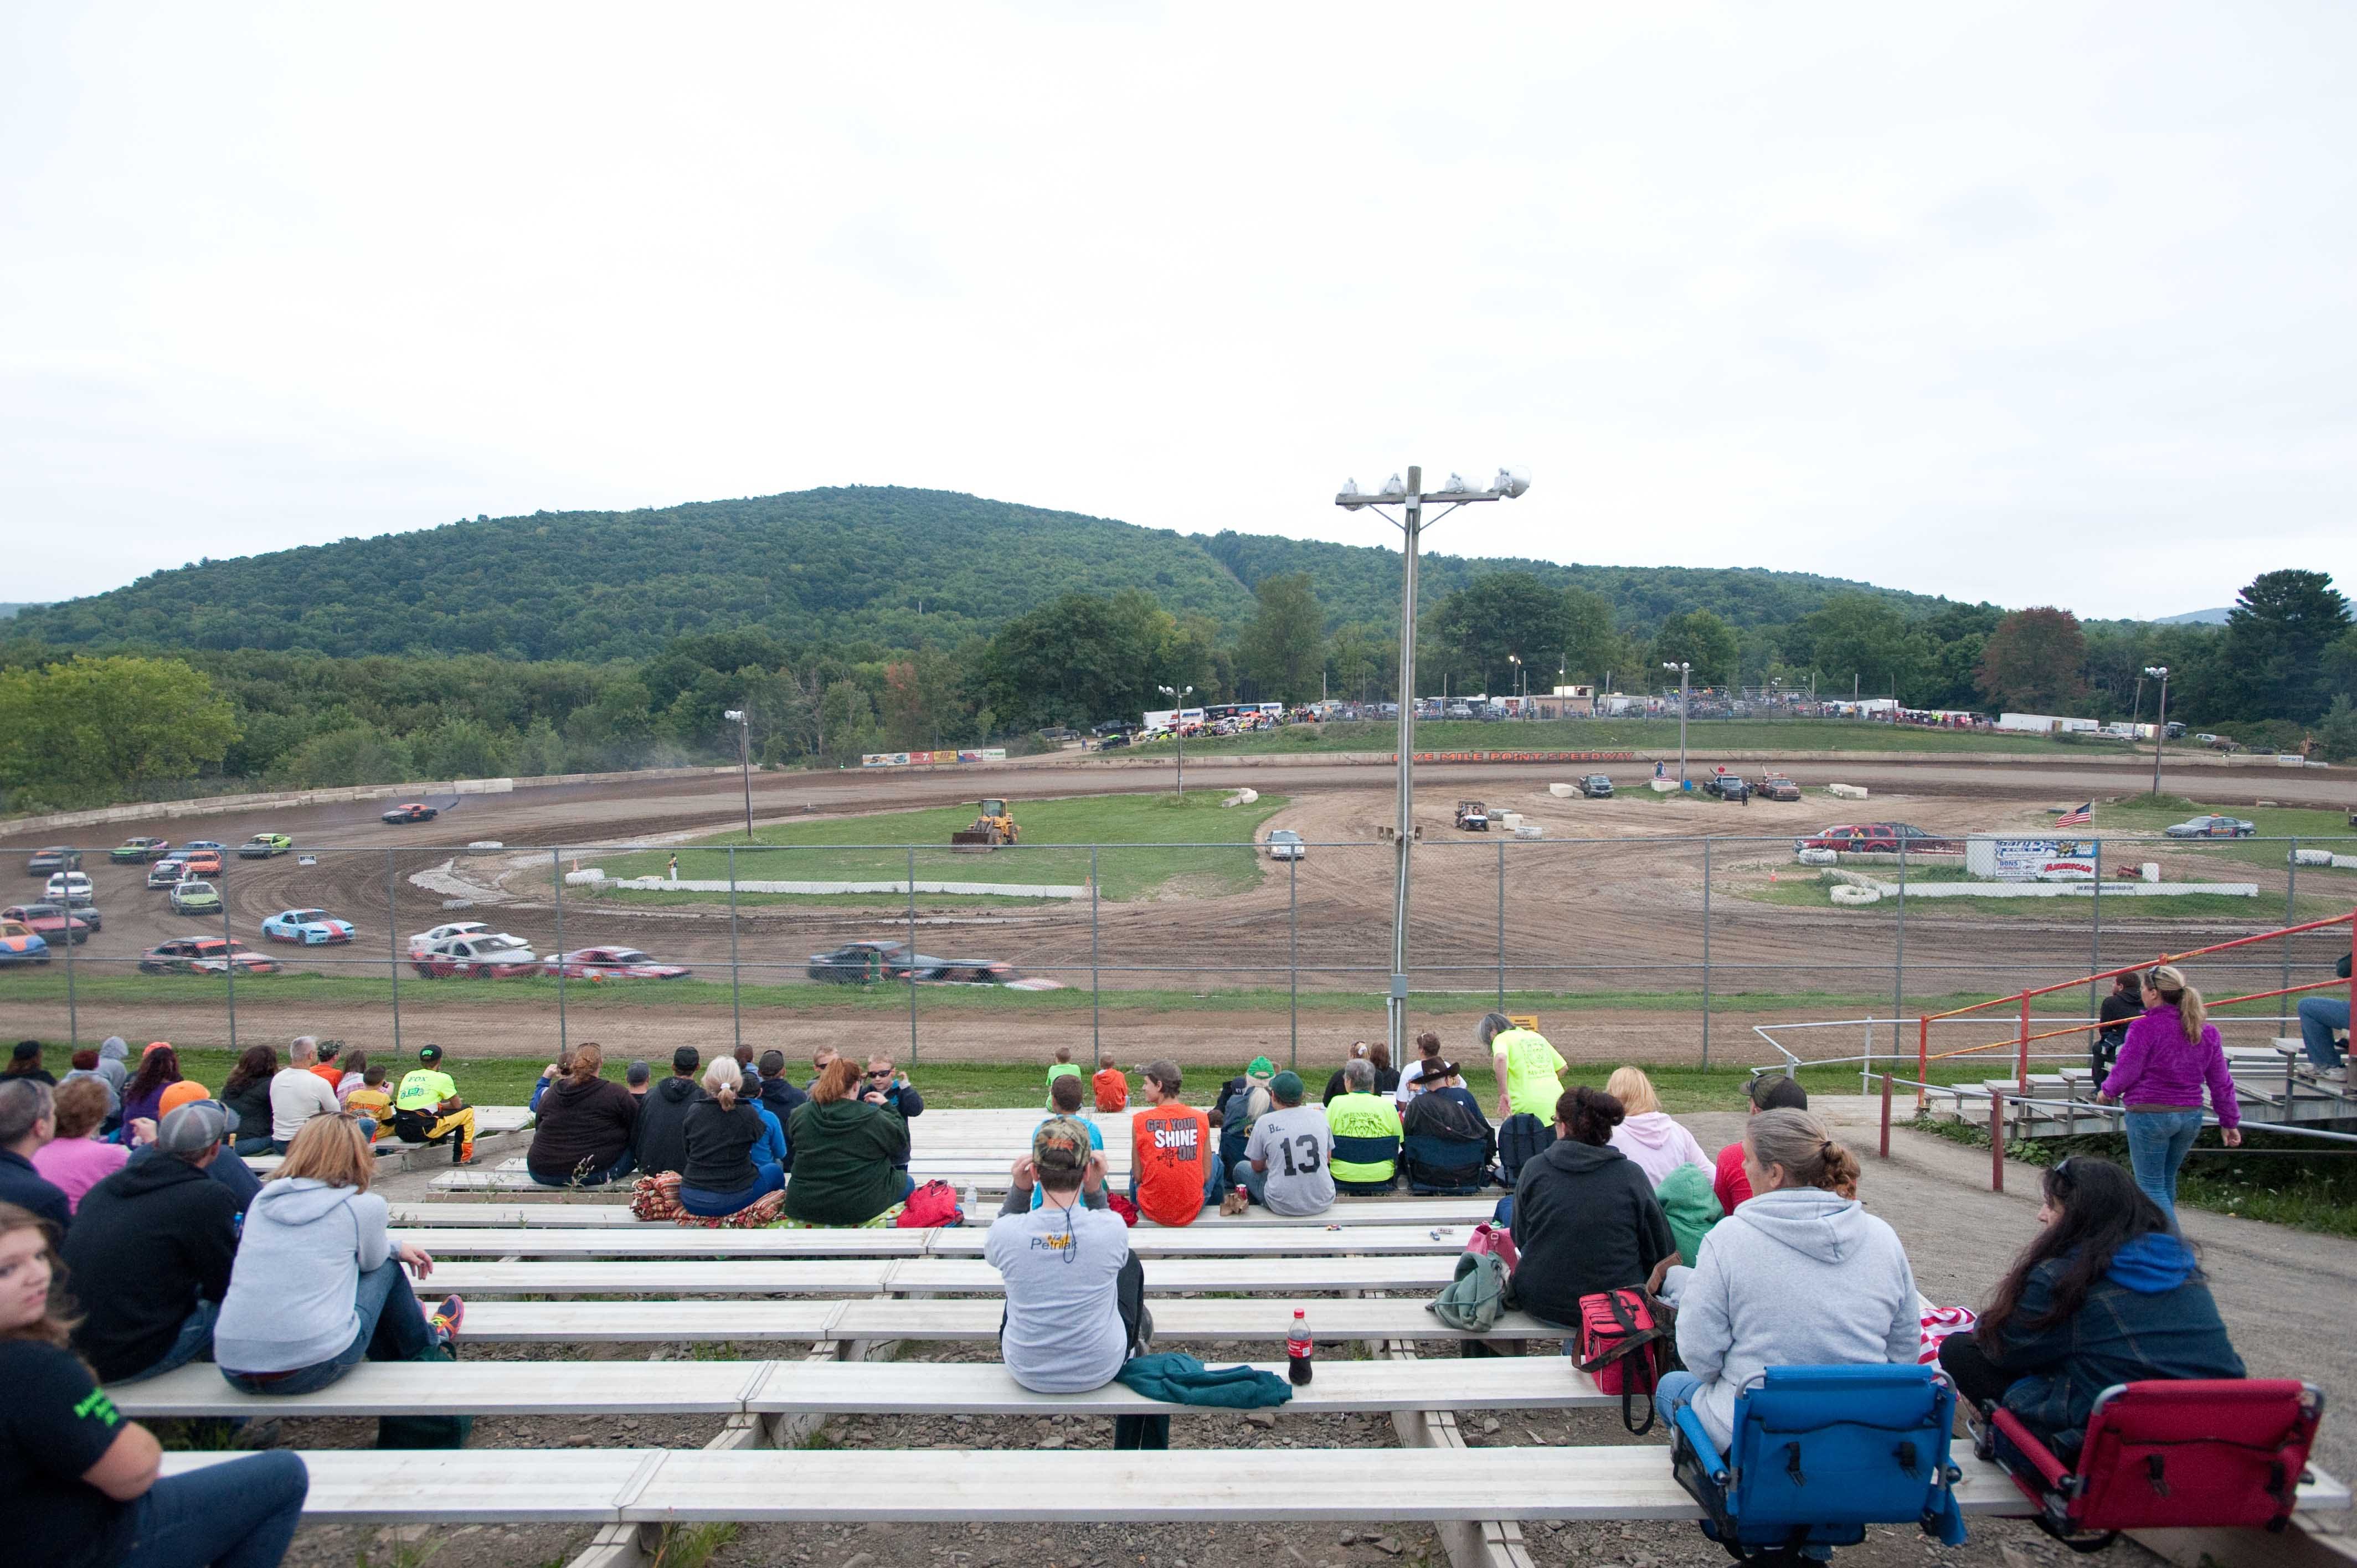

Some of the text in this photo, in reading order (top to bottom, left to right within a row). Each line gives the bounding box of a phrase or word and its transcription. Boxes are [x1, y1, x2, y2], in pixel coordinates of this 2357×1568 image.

[1440, 752, 1483, 761] MILE
[1489, 752, 1543, 761] POINT
[1547, 752, 1635, 761] SPEEDWAY
[2044, 863, 2093, 873] AMERICAN
[1146, 1117, 1197, 1133] GET YOUR
[1154, 1129, 1197, 1149] SHINE
[1177, 1146, 1197, 1161] ON!
[1280, 1134, 1320, 1177] 13
[1031, 1237, 1077, 1250] Petrilak
